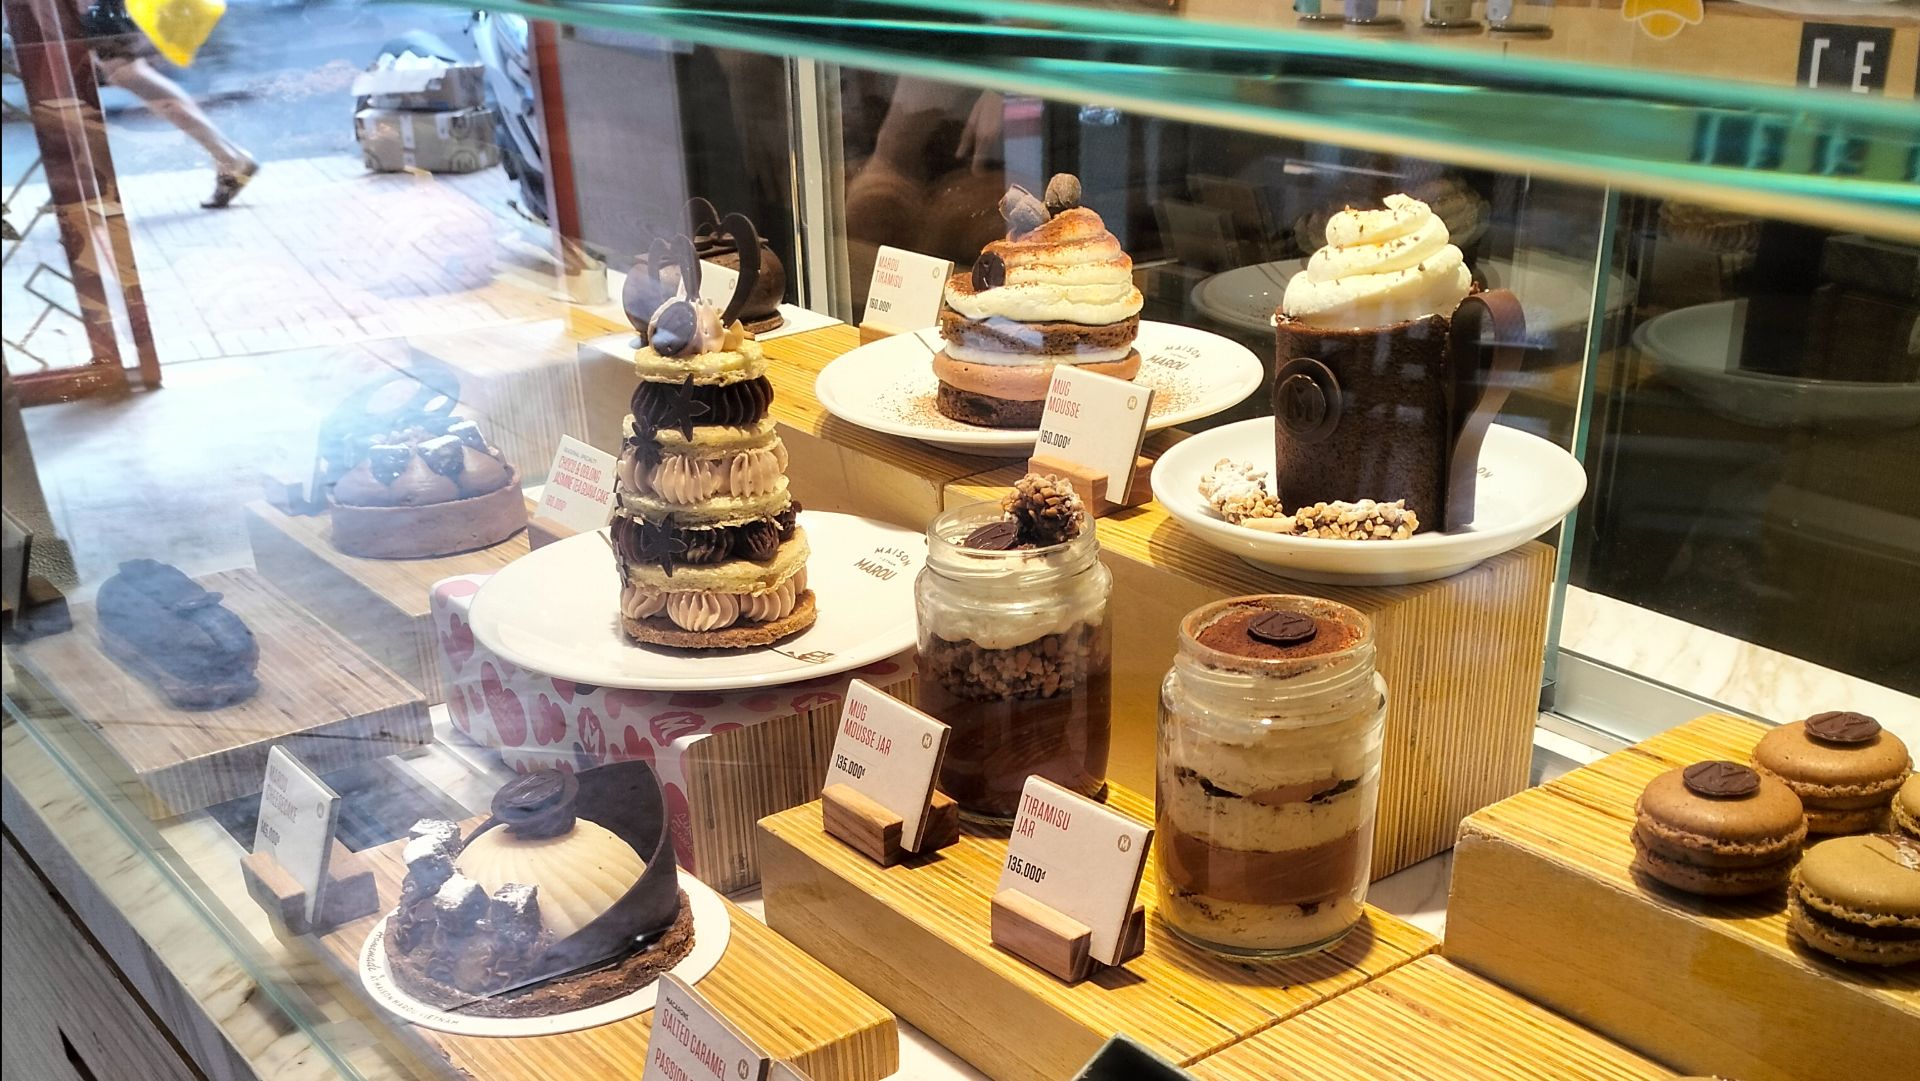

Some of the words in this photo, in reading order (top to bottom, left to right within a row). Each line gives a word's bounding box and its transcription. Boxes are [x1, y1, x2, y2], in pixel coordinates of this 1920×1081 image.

[875, 270, 903, 289] TIRAMISU
[1146, 354, 1190, 371] MAROU
[1051, 378, 1072, 397] MUG
[1047, 396, 1081, 419] MOUSSE
[874, 547, 911, 567] MAISON
[853, 557, 898, 581] MAROU
[848, 699, 868, 721] MUG
[843, 718, 877, 748] MOUSSE
[875, 735, 892, 757] JAR
[1022, 794, 1072, 831] TIRAMISU
[1016, 815, 1036, 839] JAR
[662, 1008, 691, 1047] SALTED
[689, 1034, 727, 1081] CARAMEL
